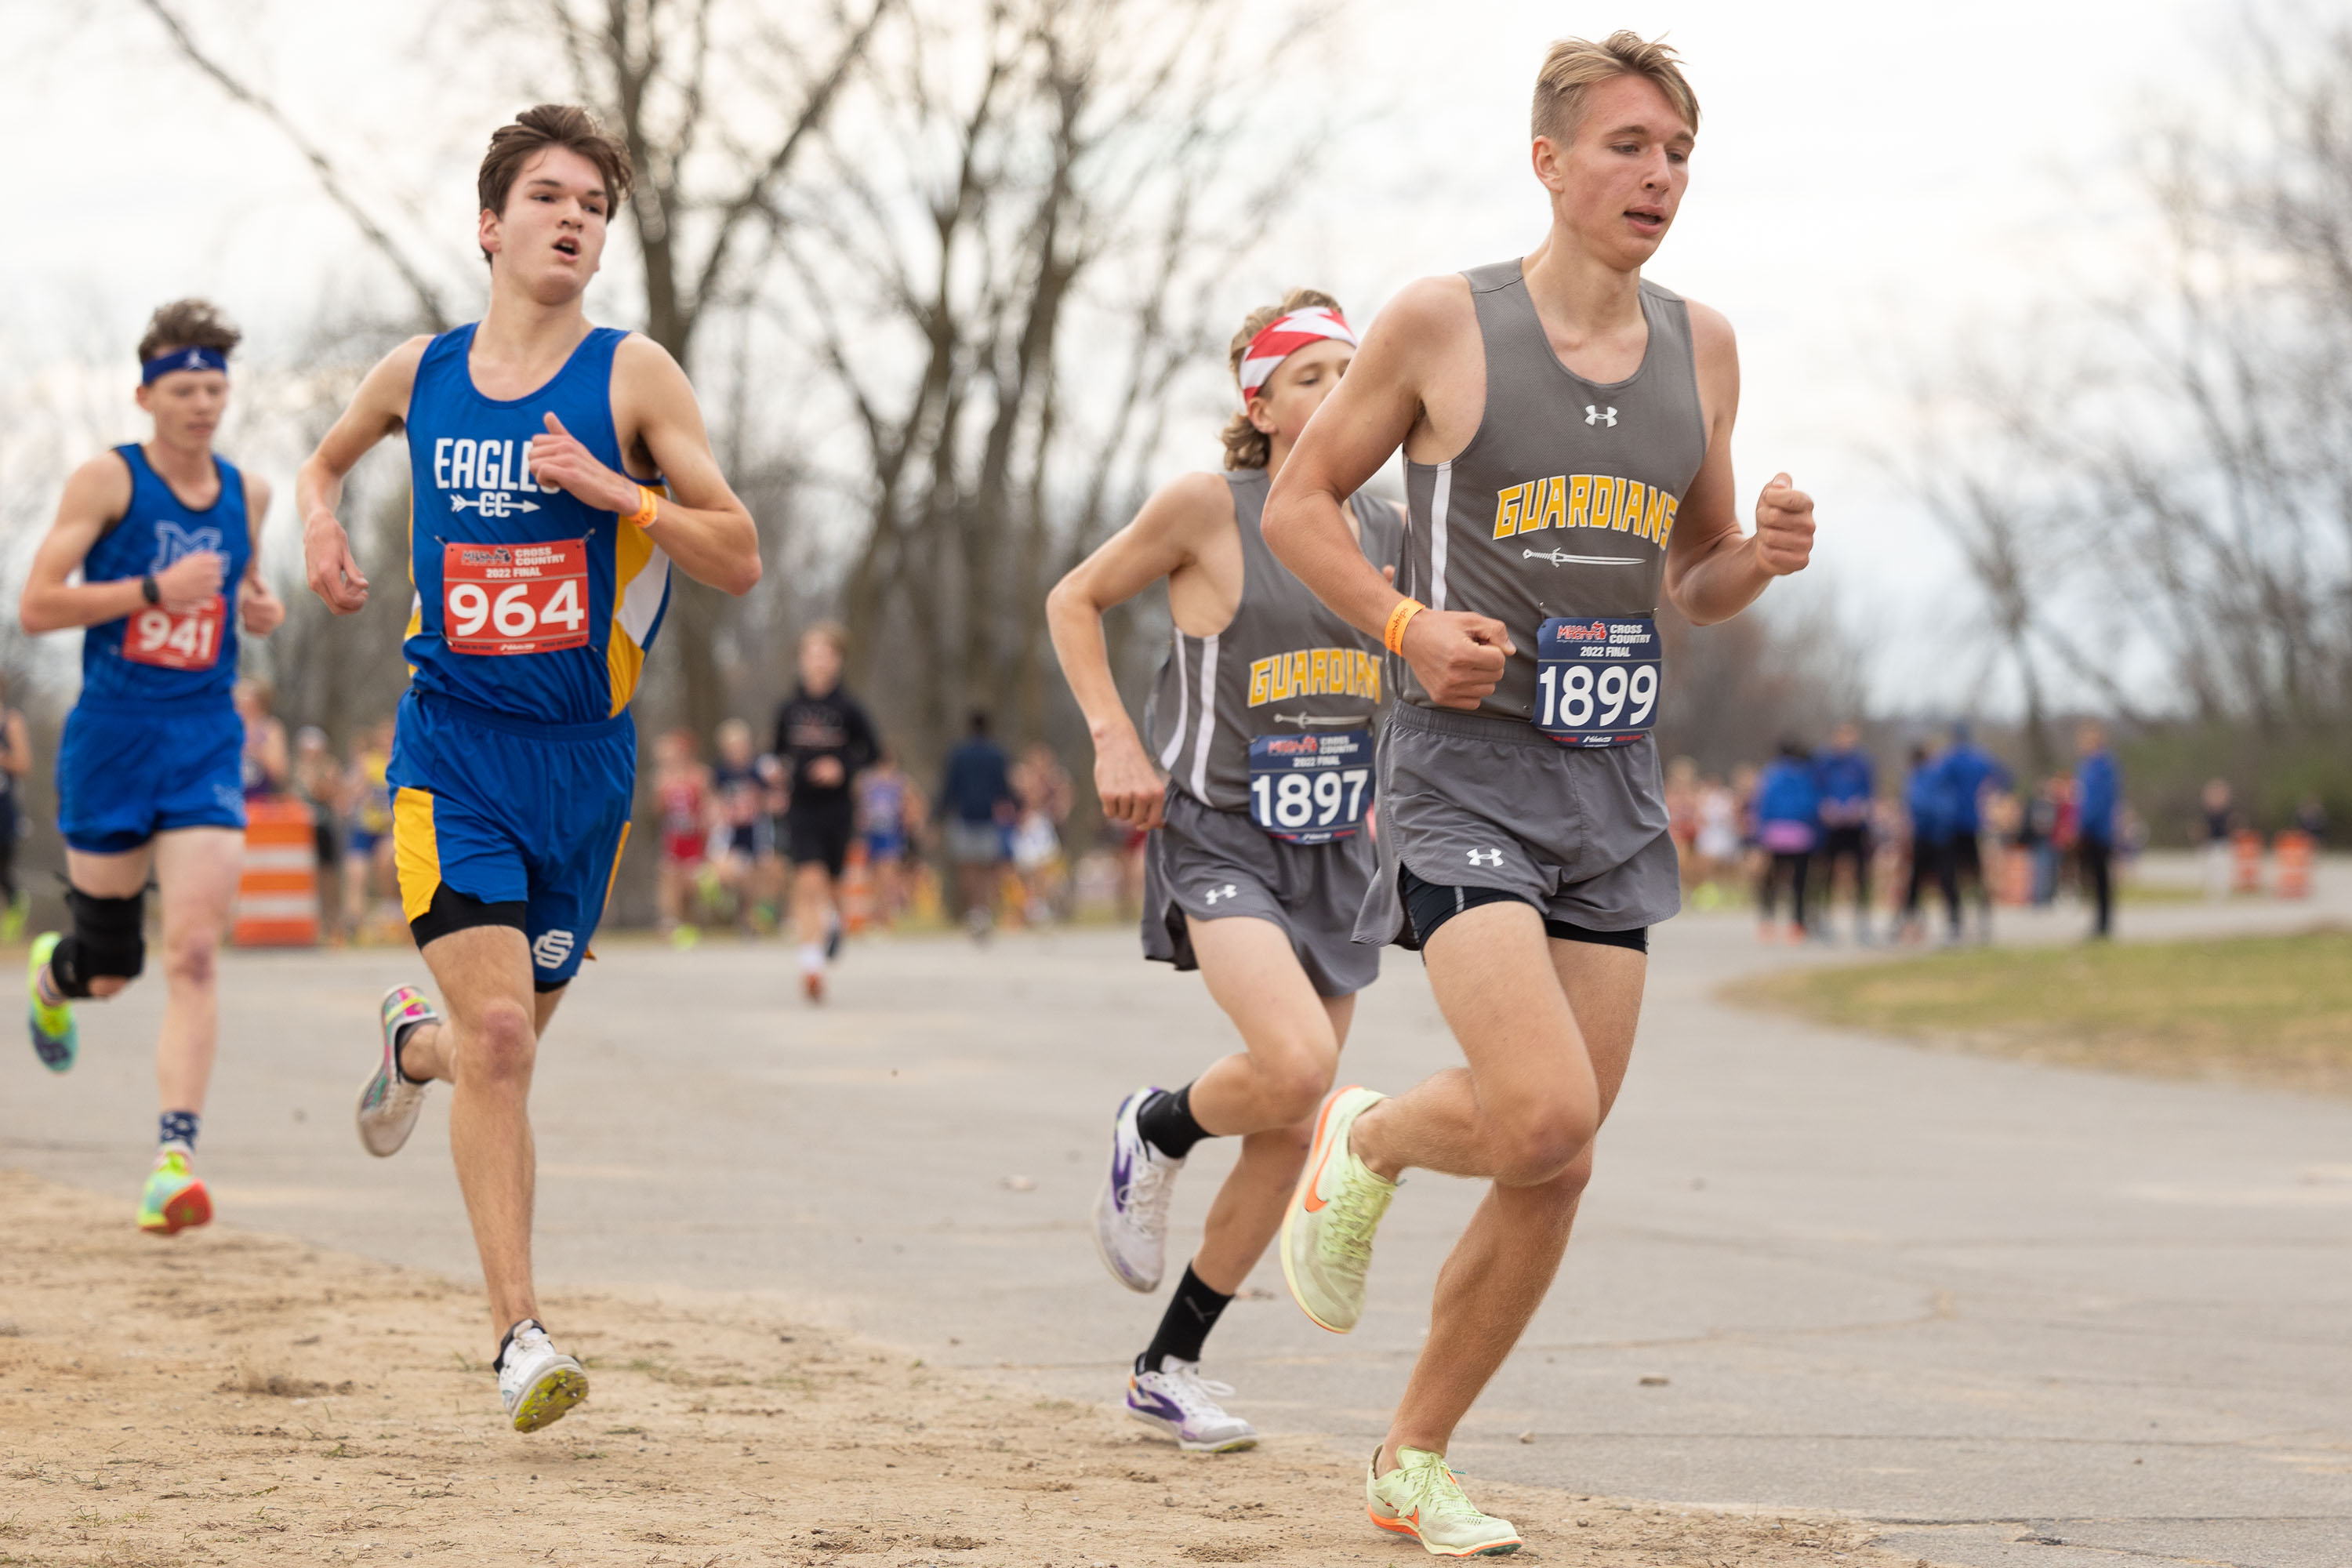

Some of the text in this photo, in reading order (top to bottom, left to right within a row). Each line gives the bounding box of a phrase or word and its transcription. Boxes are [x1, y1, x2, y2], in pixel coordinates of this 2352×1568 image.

[434, 437, 561, 494] EAGLE
[479, 492, 511, 517] CC
[1493, 474, 1679, 550] GUARDIANS
[515, 546, 552, 558] CROSS
[515, 554, 565, 566] COUNTRY
[486, 566, 543, 579] 2022 FINAL
[448, 579, 585, 637] 964
[138, 610, 215, 659] 941
[1610, 624, 1643, 633] CROSS
[1609, 633, 1651, 644] COUNTRY
[1580, 646, 1631, 657] 2022 FINAL
[1540, 665, 1657, 727] 1899
[1317, 755, 1341, 766] FINAL
[1252, 770, 1368, 828] 1897
